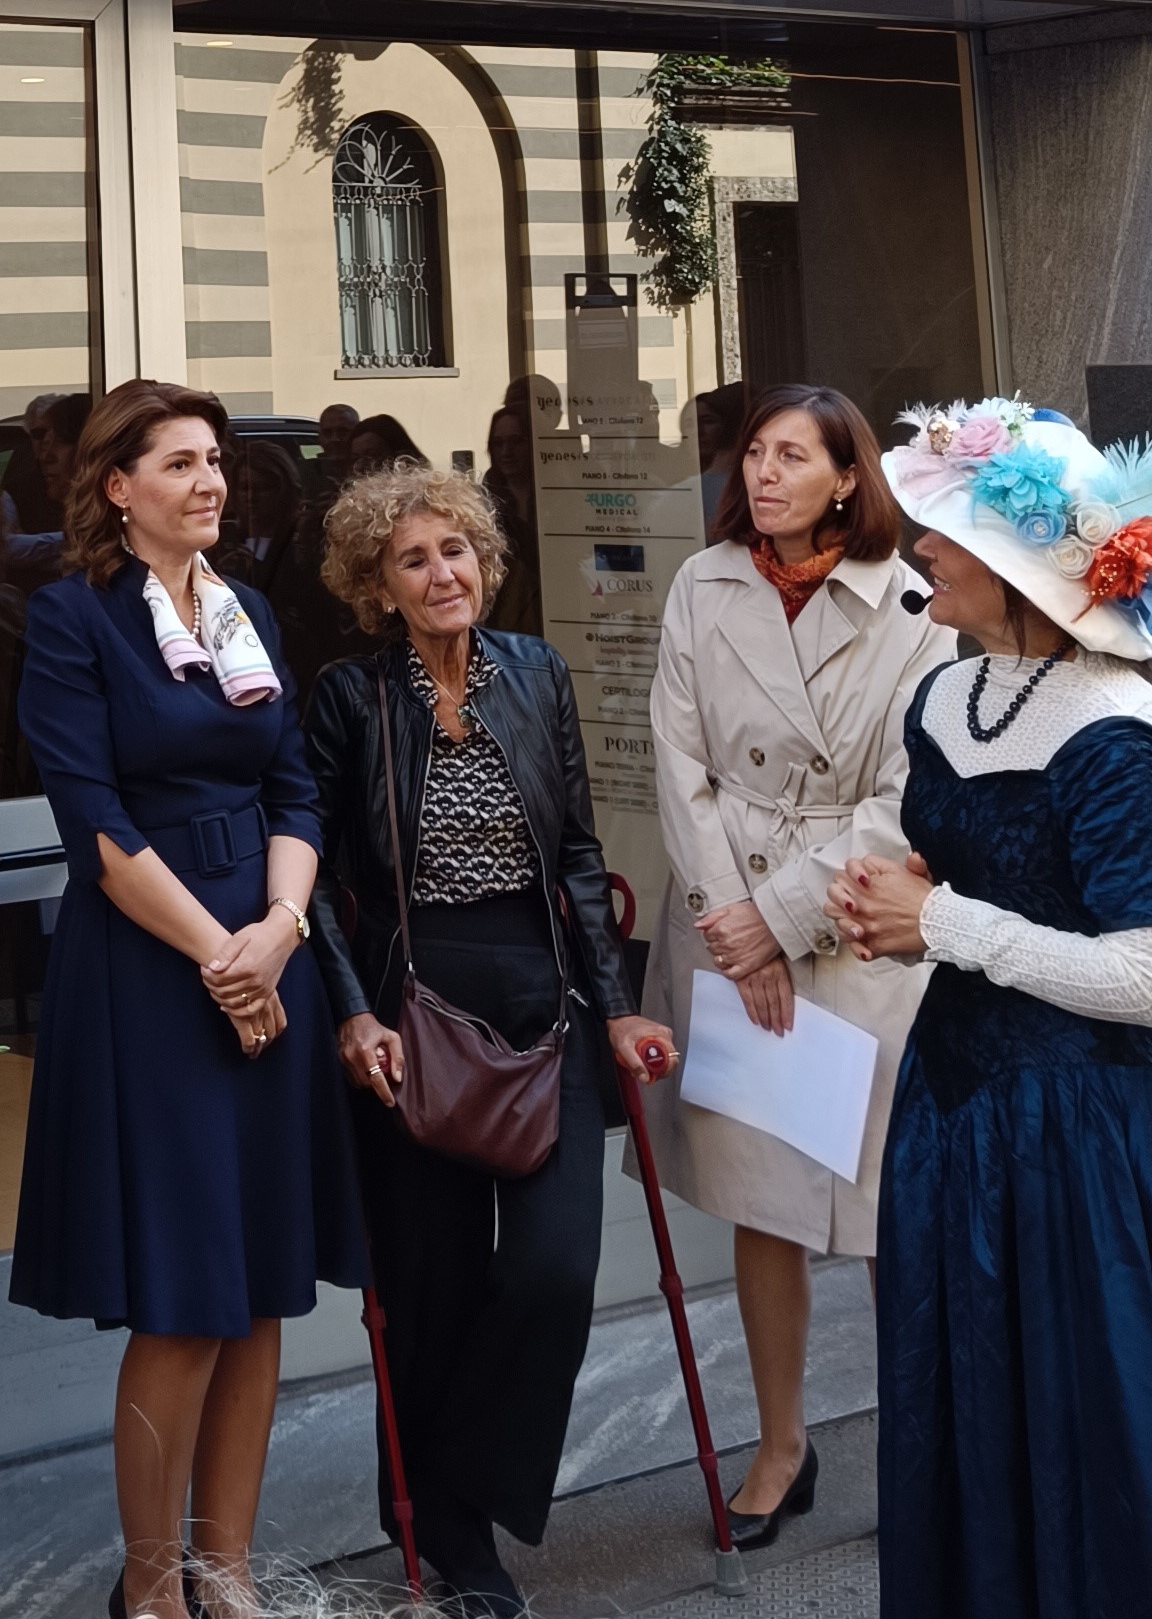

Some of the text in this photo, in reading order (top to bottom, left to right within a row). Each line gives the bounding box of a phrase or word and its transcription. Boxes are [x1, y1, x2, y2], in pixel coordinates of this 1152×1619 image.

[595, 493, 637, 508] URGO
[595, 508, 639, 516] MEDICAL
[606, 579, 654, 593] CORUS
